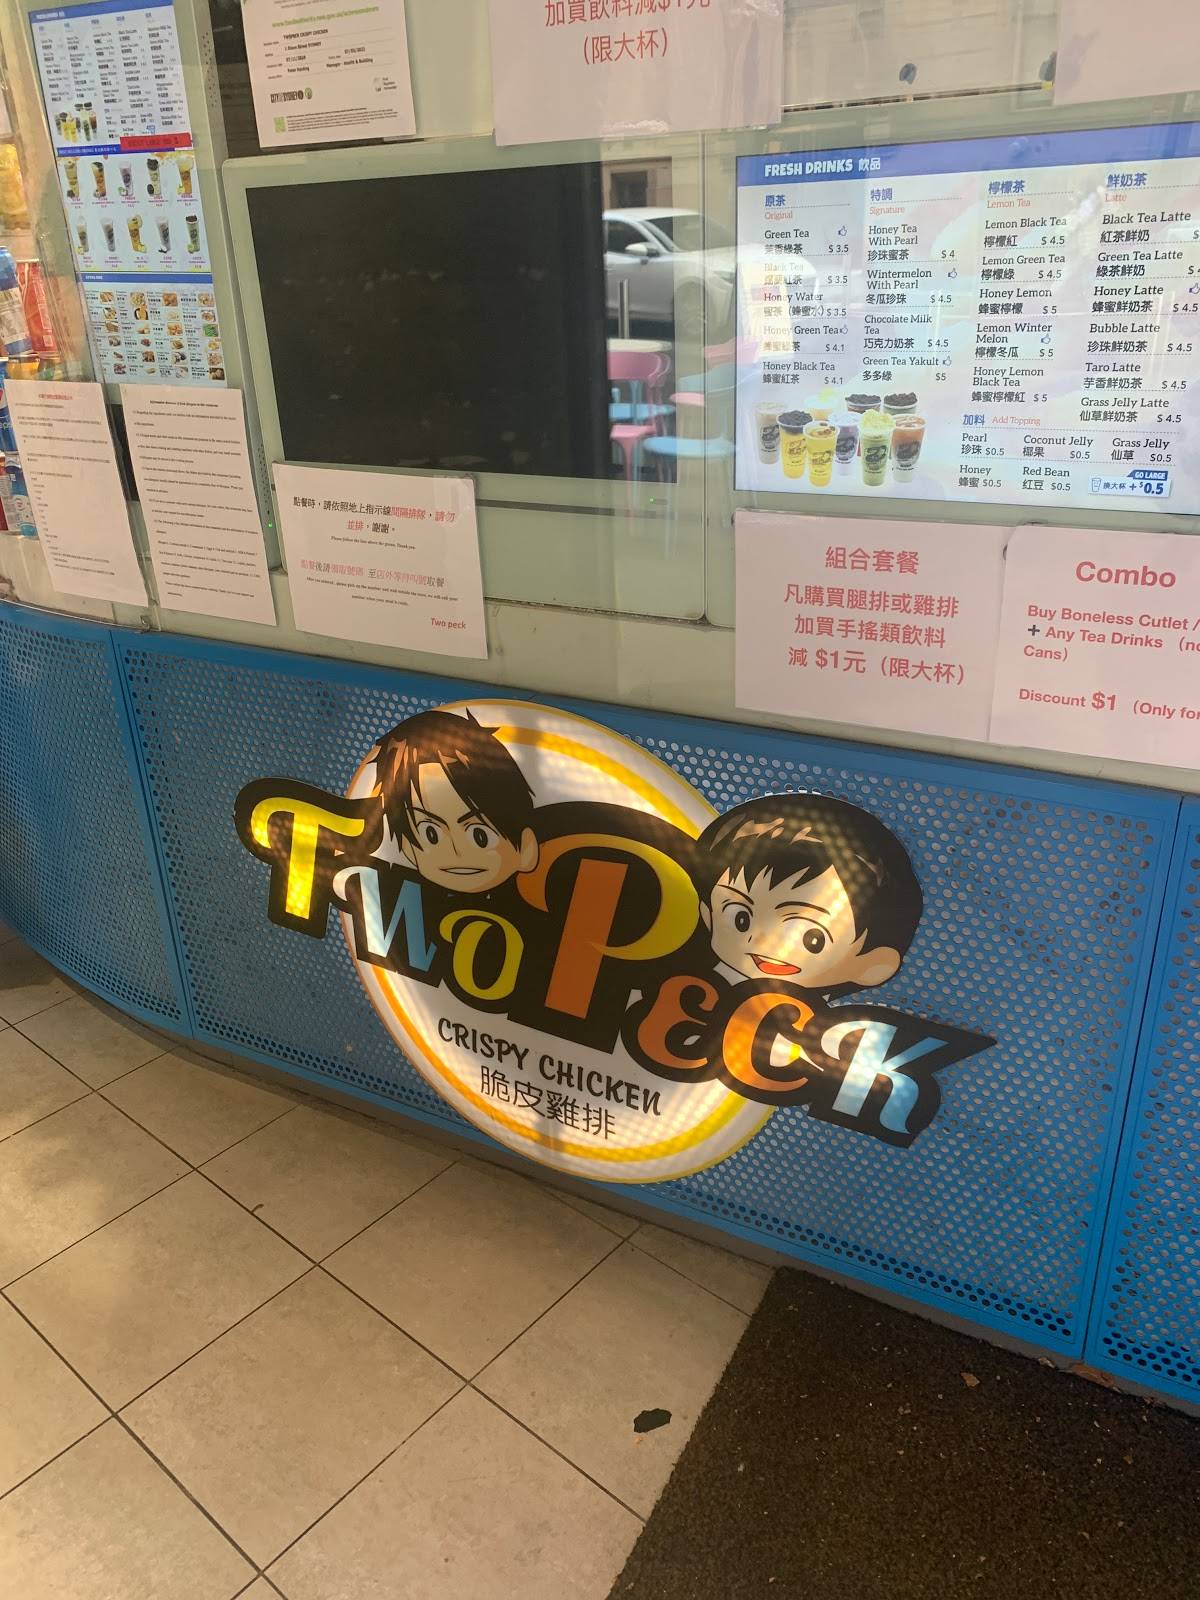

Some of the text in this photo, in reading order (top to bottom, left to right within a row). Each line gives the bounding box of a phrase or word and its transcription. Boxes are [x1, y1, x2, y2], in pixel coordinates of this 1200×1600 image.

[584, 27, 668, 65] (限大杯)
[765, 158, 881, 177] FRESH DRINKS 飲品
[1107, 172, 1148, 187] 鮮奶茶
[988, 180, 1025, 194] 檸檬茶
[870, 188, 893, 201] 特調
[1105, 193, 1128, 202] Latte
[765, 195, 785, 207] 原茶
[987, 199, 1031, 209] Lemon Tea
[765, 211, 793, 220] Original
[869, 206, 905, 215] Signature
[985, 217, 1067, 229] Lemon Black Tea
[1103, 212, 1191, 225] Black Tea Latte
[765, 229, 810, 240] Green Tea
[868, 225, 918, 236] Honey Tea
[1100, 230, 1150, 243] 紅茶鮮奶
[869, 236, 918, 246] With Pearl
[868, 249, 909, 261] 珍珠蜜茶
[982, 255, 1066, 266] Lemon Green Tea
[1098, 250, 1183, 262] Green Tea Latte
[867, 269, 932, 279] Wintermelon
[1096, 264, 1145, 277] 綠茶鮮奶
[867, 280, 919, 290] With Pearl
[1094, 285, 1164, 297] Honey Latte
[764, 293, 823, 304] Honey Water
[866, 294, 907, 305] 冬瓜珍珠
[980, 288, 1052, 300] Honey Lemon
[1092, 301, 1153, 313] 蜂蜜鮮奶茶
[865, 315, 932, 324] Chocolate Milk
[763, 326, 839, 336] Honey Green Tea
[865, 326, 880, 335] Tea
[977, 323, 1053, 333] Lemon Winter
[1090, 324, 1160, 333] Bubble Latte
[864, 338, 914, 349] 巧克力奶茶
[976, 334, 1009, 344] Melon
[975, 347, 1019, 358] 檸檬冬瓜
[1088, 341, 1148, 353] 珍珠鮮奶茶
[763, 362, 835, 372] Honey Black Tea
[863, 357, 939, 366] Green Tea Yakult
[1086, 363, 1141, 372] Taro Latte
[863, 371, 893, 381] 多多綠
[973, 367, 1044, 377] Honey Lemon
[973, 378, 1020, 387] Black Tea
[1084, 377, 1142, 390] 芋香鮮奶茶
[1081, 398, 1169, 408] Grass Jelly Latte
[963, 414, 1041, 427] 加料 Add Topping
[1080, 410, 1138, 423] 仙草鮮奶茶
[962, 433, 987, 443] Pearl
[1023, 435, 1094, 447] Coconut Jelly
[1112, 438, 1170, 450] Grass Jelly
[961, 444, 1005, 456] 珍珠 $0.5
[1023, 446, 1091, 460] 椰果 $0.5
[1111, 449, 1172, 463] 仙草 $0.5
[959, 465, 992, 476] Honey
[1022, 466, 1070, 477] Red Bean
[1134, 470, 1167, 480] GO LARGE
[958, 477, 1002, 488] 蜂蜜 $0.5
[1051, 482, 1071, 491] $0.5
[825, 546, 919, 576] 組合套餐
[1076, 561, 1177, 588] Combo
[783, 584, 960, 620] 凡購買腿排或雞排
[431, 617, 466, 630] Two peck
[1028, 605, 1057, 620] Buy
[1061, 608, 1134, 626] Boneless
[1139, 614, 1189, 631] Cutlet
[793, 614, 946, 649] 加買手搖類飲料
[1045, 627, 1075, 643] Any
[1079, 629, 1106, 643] Tea
[1111, 632, 1163, 648] Drinks
[1024, 645, 1069, 662] Cans)
[1019, 688, 1086, 707] Discount
[1092, 691, 1117, 711] $1
[1133, 700, 1175, 720] (Only
[437, 1016, 663, 1118] CRISPY CHICKEN
[479, 1063, 618, 1142] 脆皮雞排
